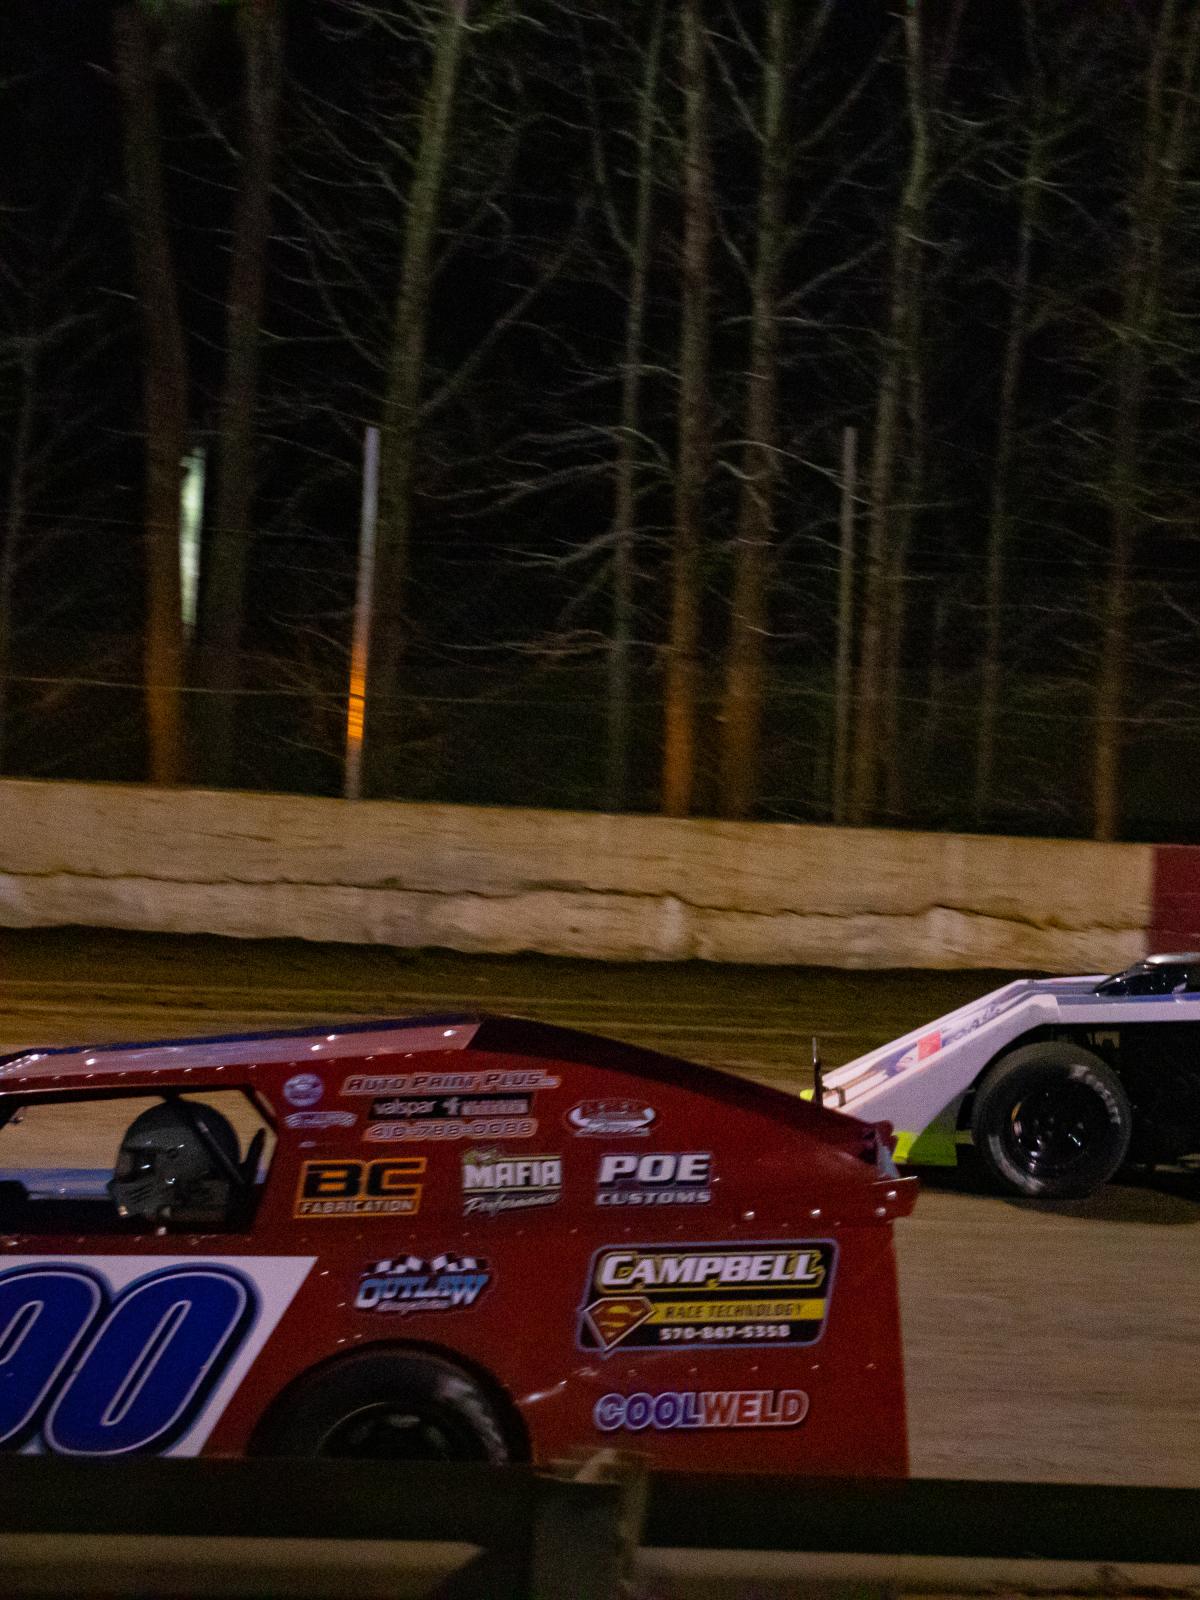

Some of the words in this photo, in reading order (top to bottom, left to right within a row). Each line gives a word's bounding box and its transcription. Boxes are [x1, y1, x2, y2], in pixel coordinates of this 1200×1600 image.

[303, 1160, 421, 1198] BC
[463, 1161, 561, 1188] MAFIA
[598, 1154, 711, 1182] POE
[301, 1200, 413, 1214] FABRICATION
[596, 1191, 711, 1205] CUSTOMS
[601, 1251, 821, 1285] CAMPBELL
[355, 1274, 489, 1309] OUTLAW
